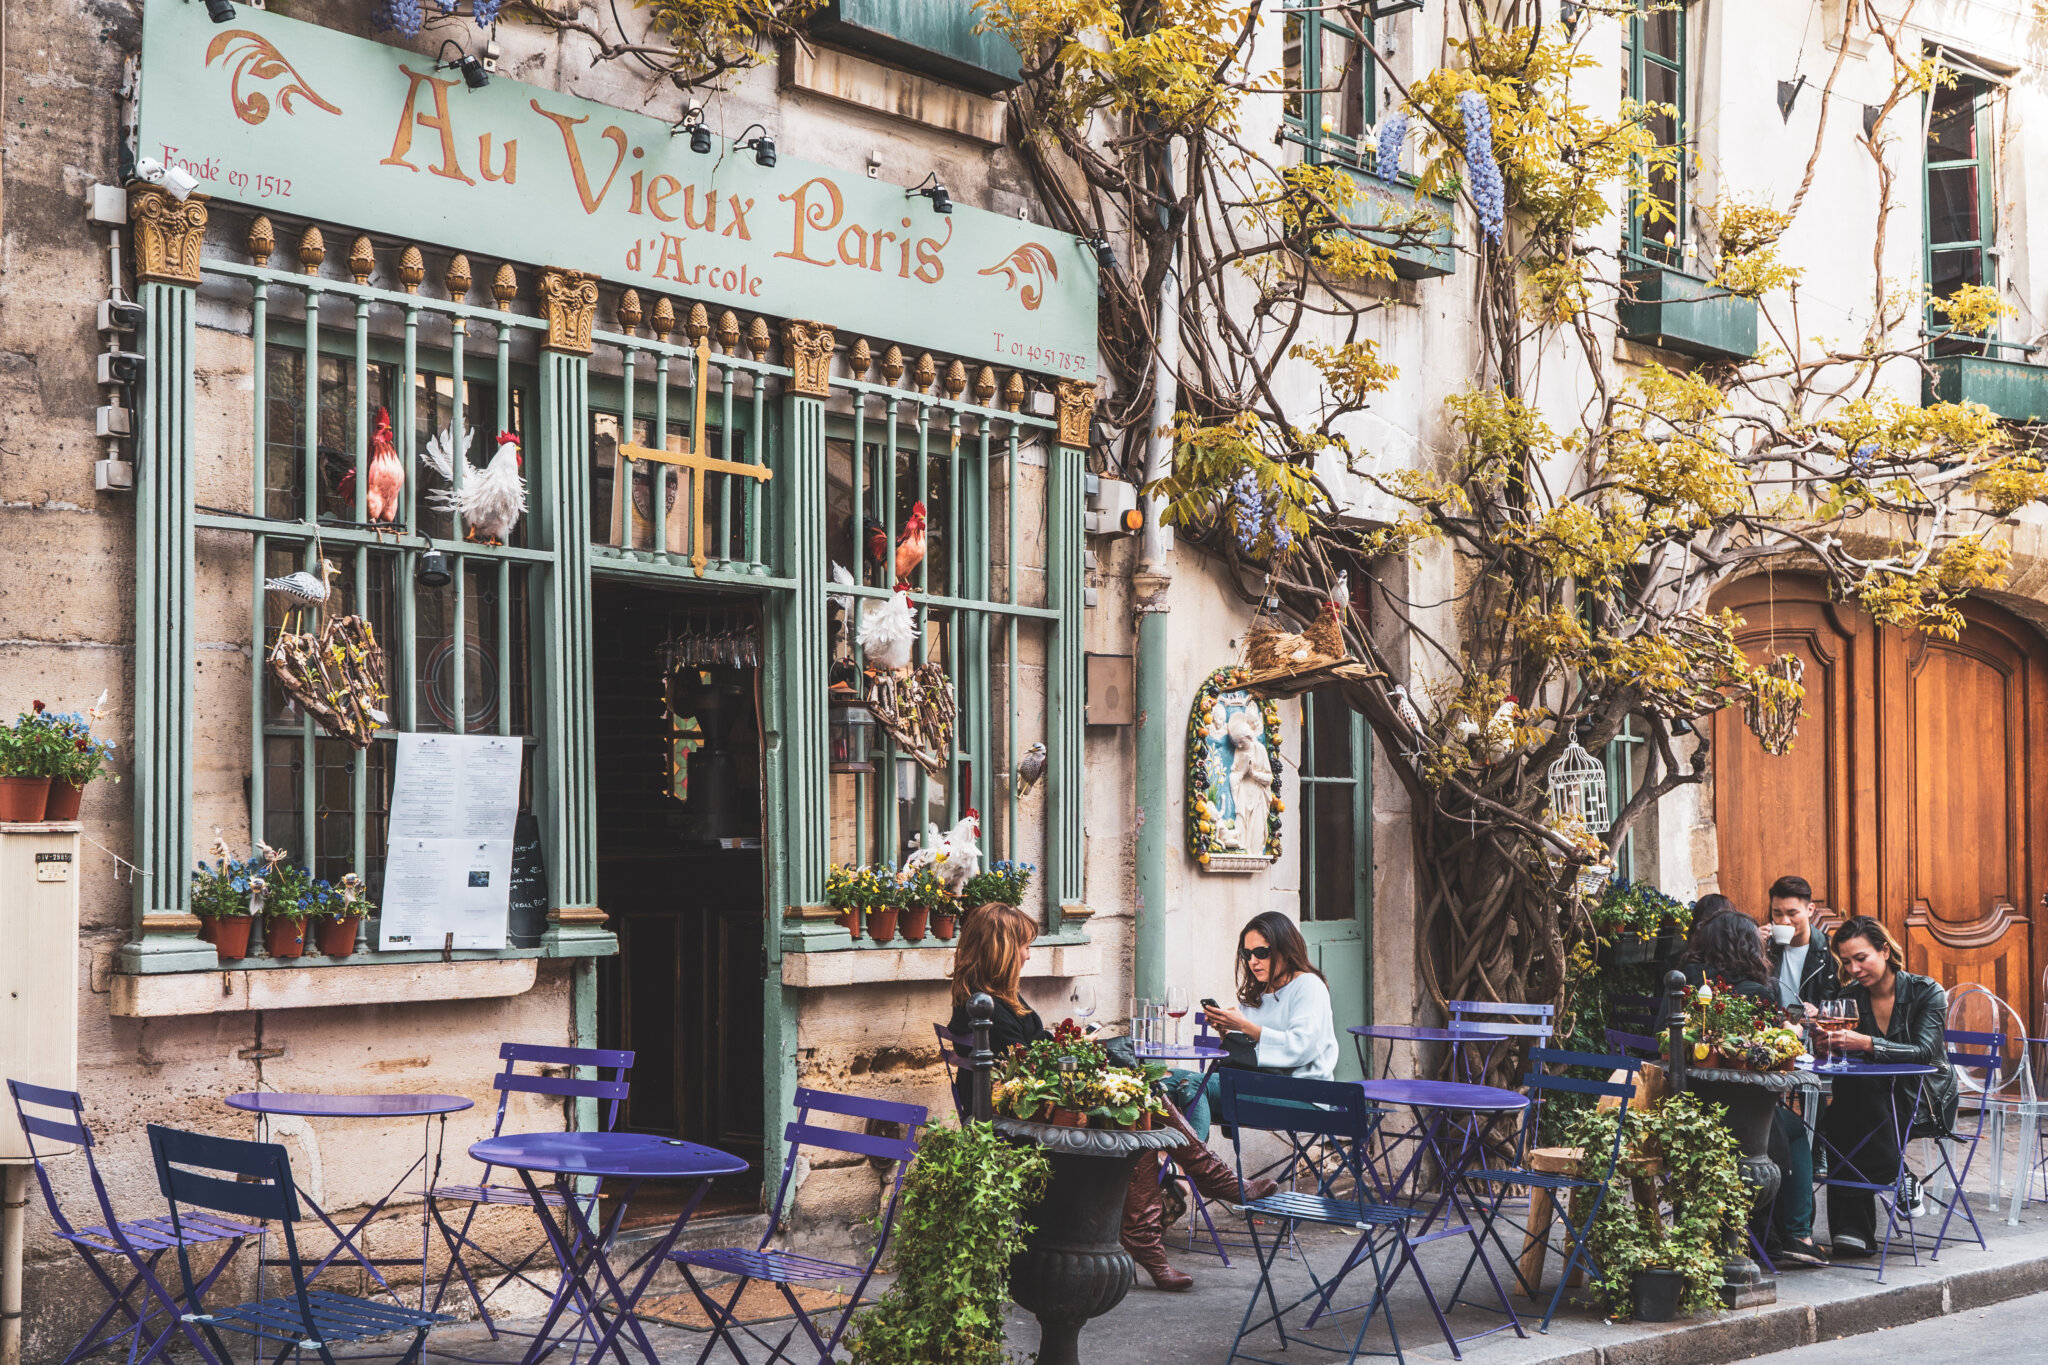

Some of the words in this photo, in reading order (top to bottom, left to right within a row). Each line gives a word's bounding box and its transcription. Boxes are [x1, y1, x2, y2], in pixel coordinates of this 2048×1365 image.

[158, 142, 220, 182] Fondé
[228, 170, 249, 197] en
[255, 173, 292, 198] 1512
[379, 63, 518, 187] Au
[529, 98, 755, 241] Vieux
[772, 176, 953, 285] Paris
[625, 231, 763, 298] d'Arcole
[1011, 341, 1023, 357] 01
[1026, 345, 1042, 362] 40
[1042, 348, 1055, 366] 51
[1058, 351, 1071, 370] 78
[1072, 355, 1086, 373] 52
